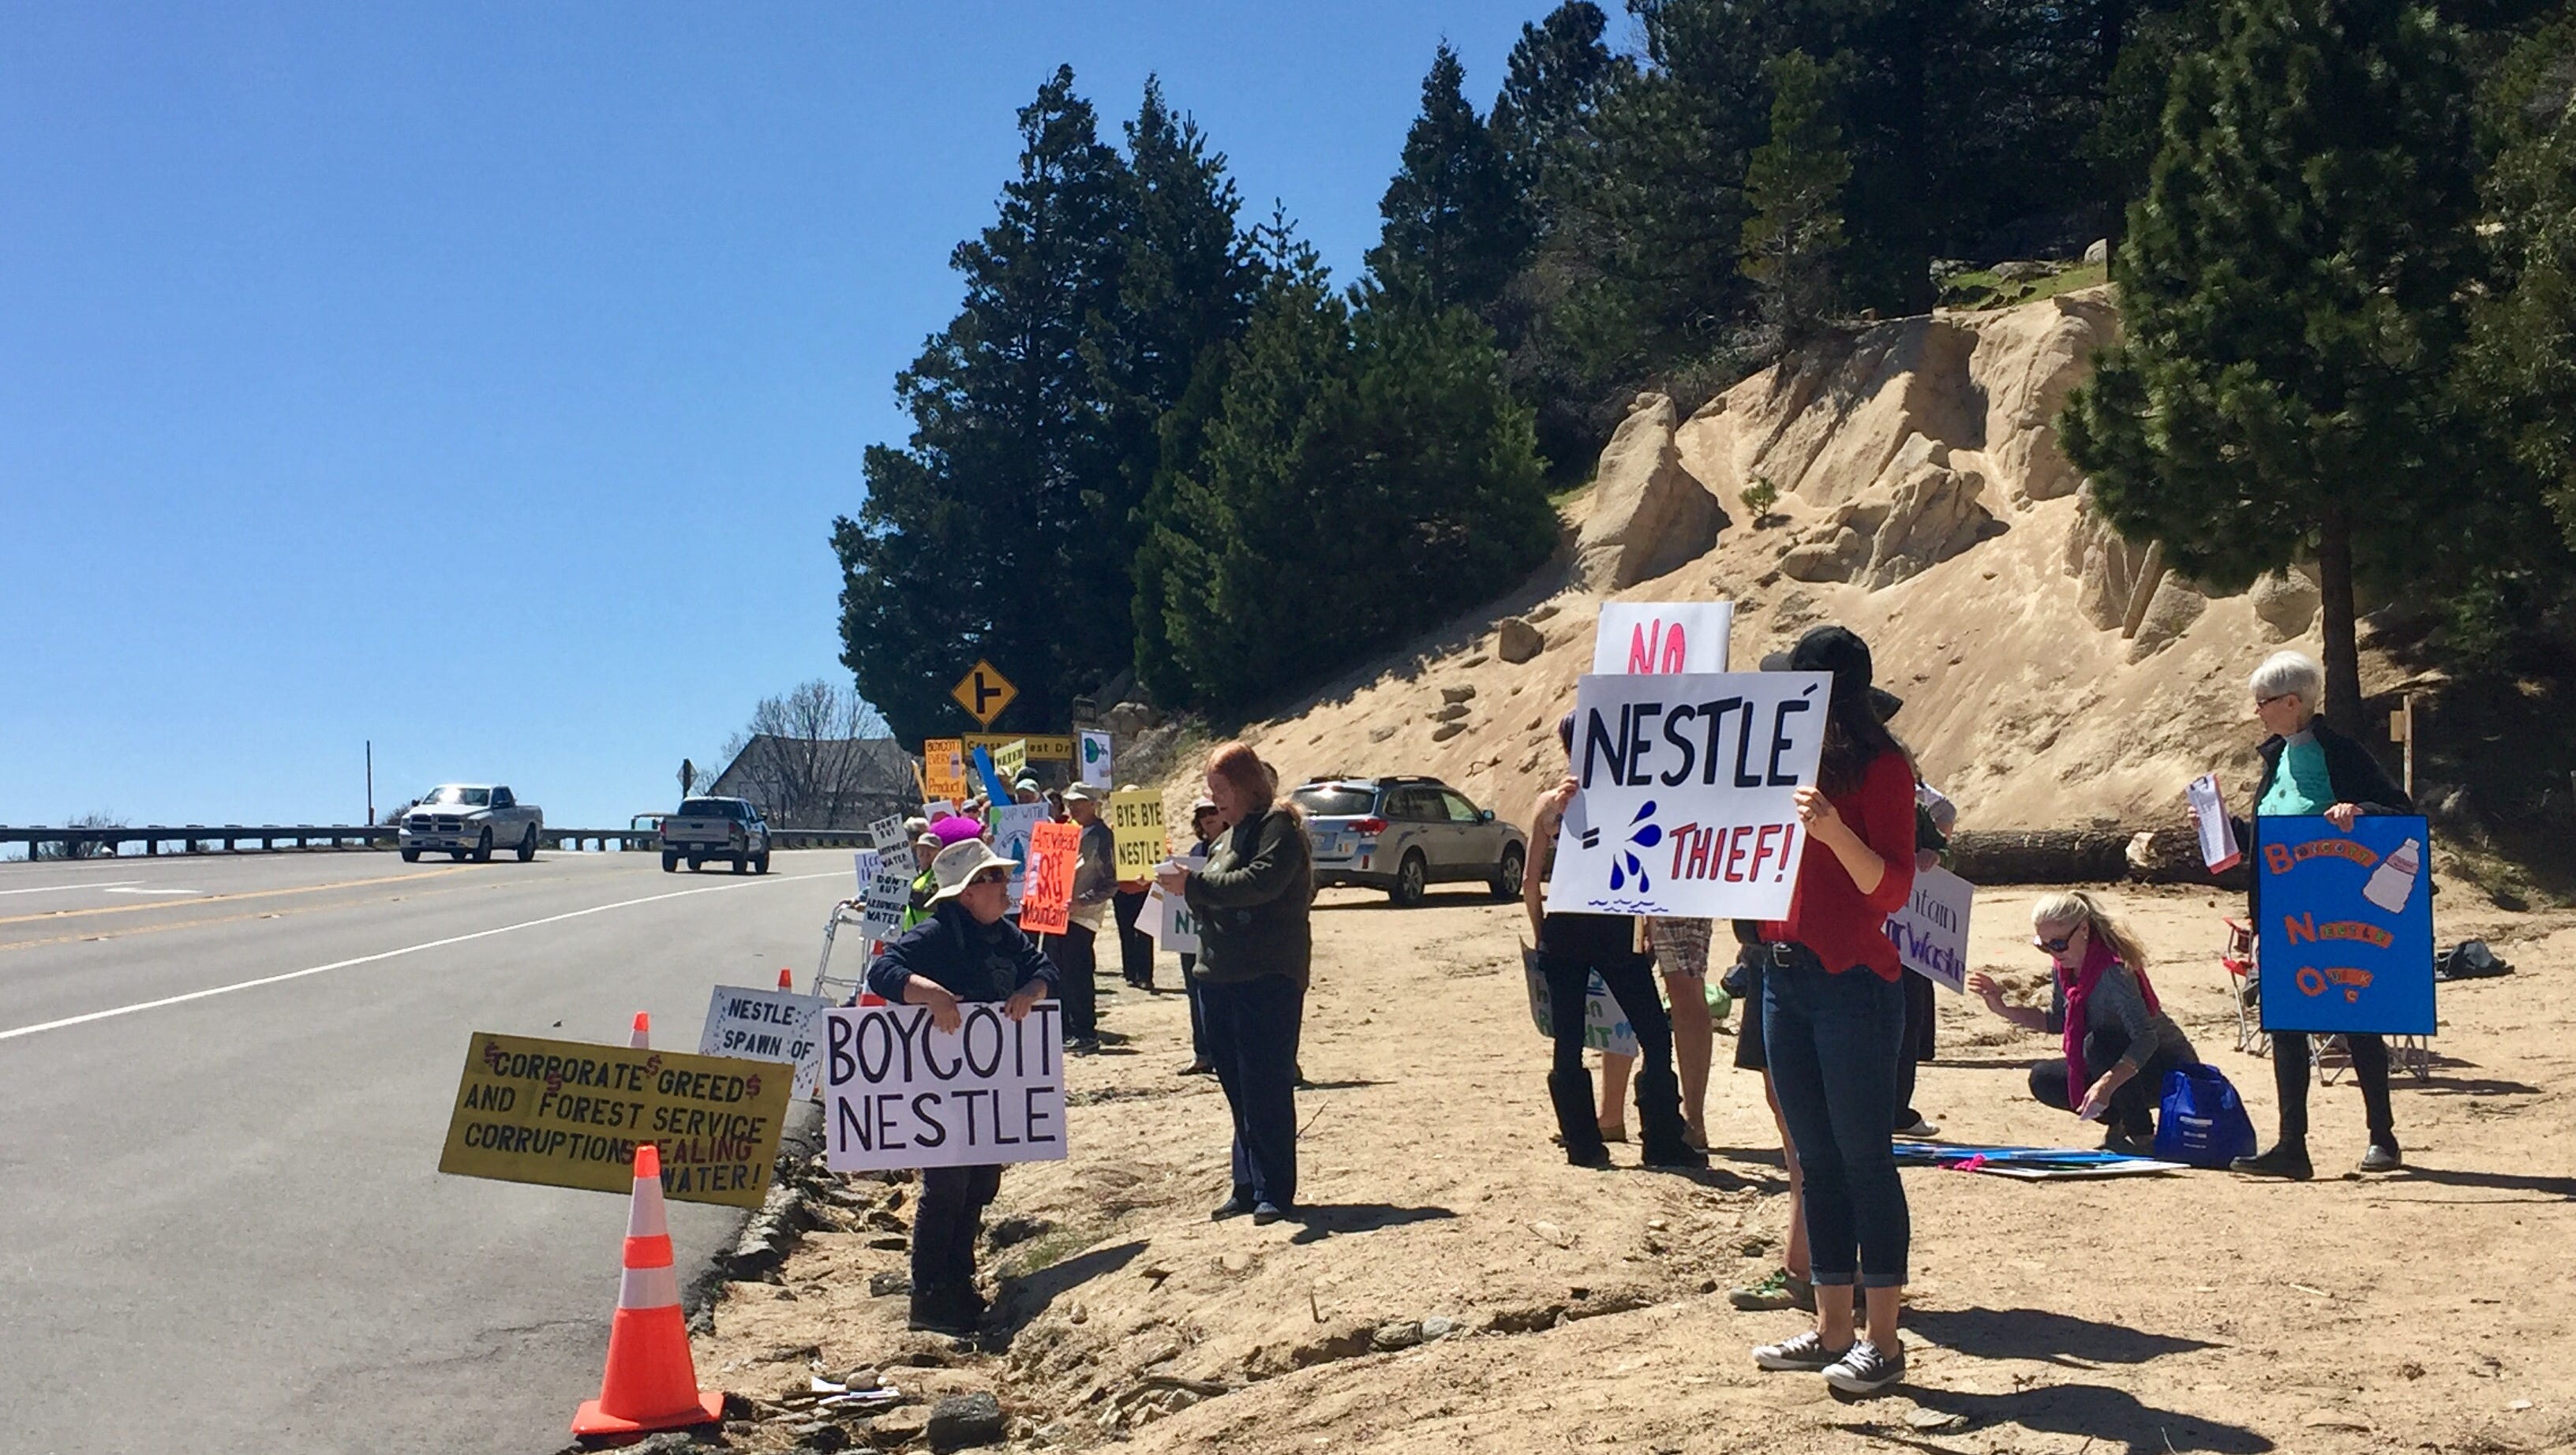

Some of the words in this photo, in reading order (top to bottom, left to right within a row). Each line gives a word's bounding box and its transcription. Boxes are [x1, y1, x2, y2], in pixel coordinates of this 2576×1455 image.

[1628, 619, 1686, 674] NO
[1055, 742, 1070, 752] Dr
[1582, 683, 1818, 789] NESTLÉ
[1116, 804, 1137, 827] BYE
[1140, 802, 1162, 826] BYE
[1119, 841, 1161, 865] NESTLE
[1668, 822, 1795, 882] THIEF!
[867, 911, 901, 924] WATER
[723, 1030, 783, 1057] SPAWN
[791, 1040, 815, 1060] OF
[828, 1004, 1059, 1086] BOYCOTT
[464, 1084, 516, 1112] AND
[538, 1092, 646, 1129] FOREST
[652, 1106, 766, 1143] SERVICE
[838, 1087, 1057, 1152] NESTLE
[621, 1138, 752, 1165] SEALING
